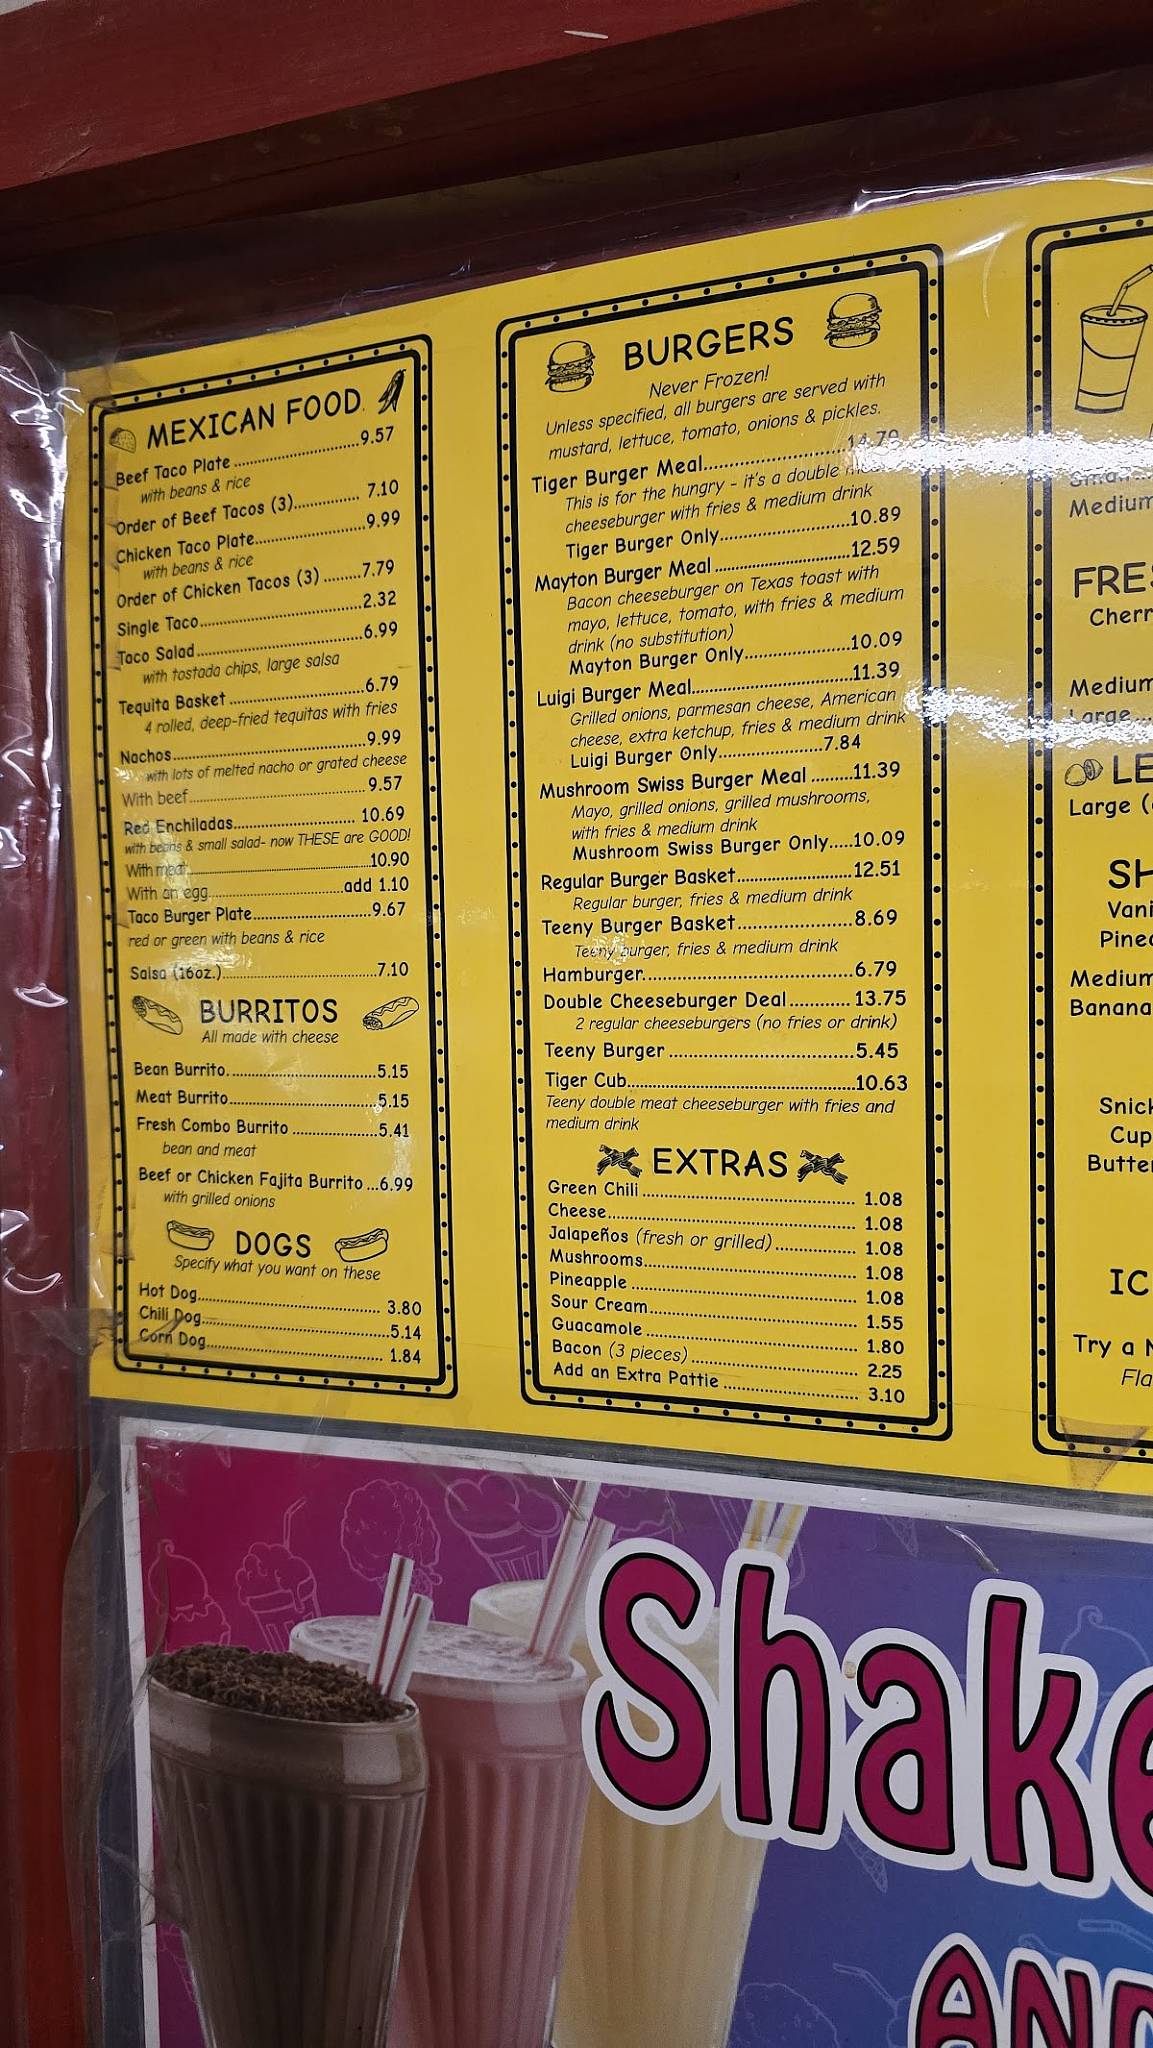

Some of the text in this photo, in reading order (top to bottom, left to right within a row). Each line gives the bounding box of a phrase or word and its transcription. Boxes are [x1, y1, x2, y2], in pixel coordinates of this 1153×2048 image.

[625, 317, 793, 370] BURGERS
[649, 365, 769, 398] Never Frozen!
[148, 388, 361, 449] MEXICAN FOOD
[549, 402, 880, 460] mustard, lettuce, tomato, onions & pickles.
[116, 426, 394, 486] Beef Taco Plate 9.57
[141, 476, 251, 504] with beans & rice
[532, 455, 702, 495] Tiger Burger Meal
[116, 479, 398, 535] Order of Beef Tacos (3) 7.10
[1069, 495, 1153, 518] Medium
[116, 510, 400, 564] Chicken Taco Plate 9.99
[535, 537, 900, 593] Mayton Burger Meal 12.59
[1075, 562, 1153, 598] FRE
[117, 590, 396, 637] Single Taco 2.32
[118, 621, 397, 665] Taco Salad 6.99
[569, 623, 733, 654] drink (no substitution)
[119, 675, 398, 716] Tequita Basket 6.79
[1070, 676, 1153, 697] Medium
[145, 701, 397, 734] 4 rolled, deep-fried tequitas with fries
[120, 729, 400, 765] Nachos 9.99
[571, 734, 860, 770] Luigi Burger Only 7.84
[540, 761, 900, 799] Mushroom Swiss Burger Meal 11.39
[1070, 799, 1130, 818] Large
[542, 860, 900, 893] Regular Burger Basket 12.51
[128, 902, 406, 925] Taco Burger Plate 9.67
[573, 887, 853, 912] Regular burger, fries & medium drink
[544, 961, 896, 984] Hamburger 6.79
[1070, 969, 1153, 987] Medium
[200, 999, 337, 1023] BURRITOS
[544, 990, 906, 1011] Double Cheeseburger Deal 13.75
[1071, 999, 1151, 1016] Banana
[202, 1030, 339, 1043] All made with cheese
[544, 1042, 898, 1061] Teeny Burger 5.45
[134, 1062, 408, 1078] Bean Burrito 5.15
[545, 1072, 907, 1091] Tiger Cub 10.63
[137, 1117, 409, 1137] Fresh Combo Burrito 5.41
[1111, 1126, 1152, 1148] Cup
[654, 1148, 787, 1178] EXTRAS
[1088, 1154, 1153, 1173] Butte
[139, 1167, 413, 1191] Beef or Chicken Fajita Burrito 6.99
[548, 1180, 902, 1206] Green Chili 1.08
[548, 1203, 902, 1231] Cheese 1.08
[237, 1231, 311, 1258] DOGS
[549, 1226, 903, 1256] Jalapeños (fresh or grilled) 1.08
[1110, 1269, 1149, 1296] IC
[140, 1282, 421, 1316] Hot Dog 3.80
[552, 1317, 904, 1355] Guacamole 1.80
[1073, 1334, 1134, 1358] Try a
[553, 1339, 902, 1379] Bacon (3 pieces) 2.25
[554, 1362, 904, 1403] Add an Extra Pattie 3.10
